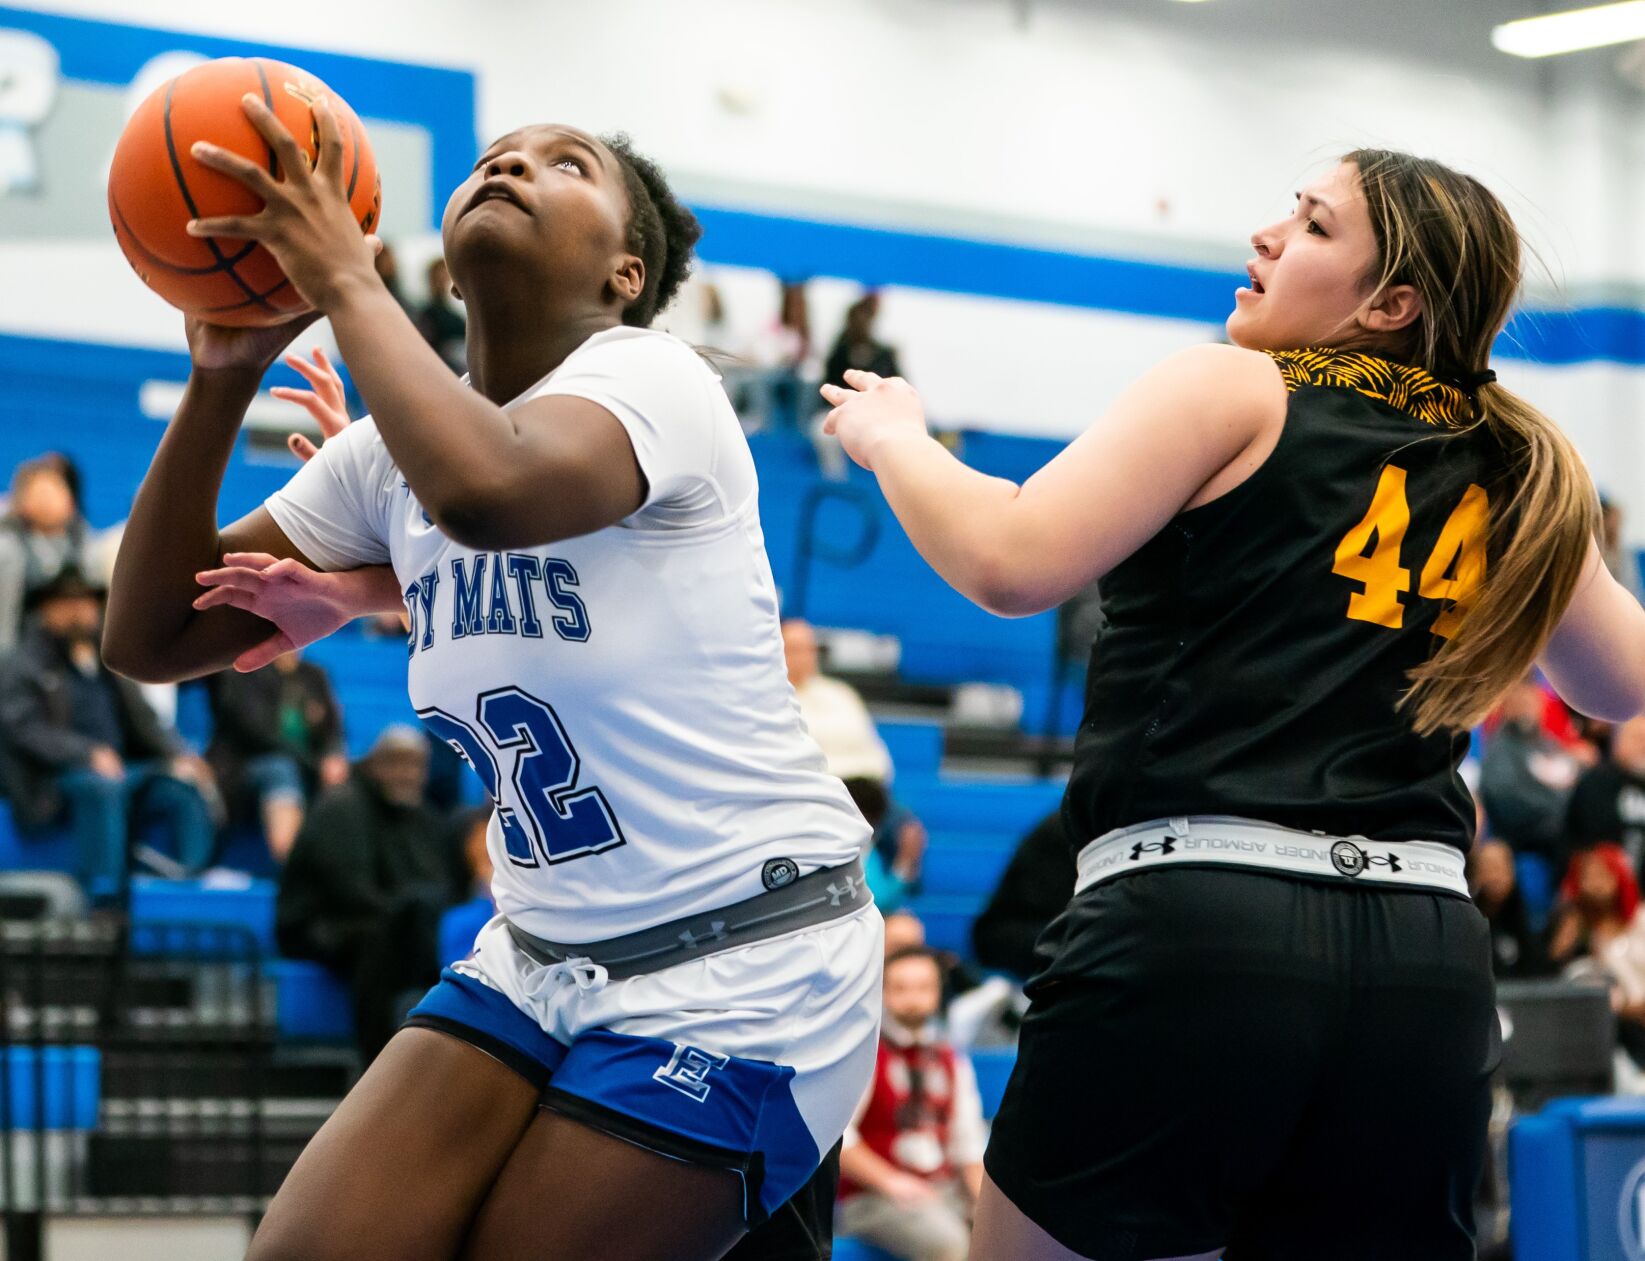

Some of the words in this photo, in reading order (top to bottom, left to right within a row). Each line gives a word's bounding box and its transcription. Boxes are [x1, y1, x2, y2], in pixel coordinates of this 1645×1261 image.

[1331, 463, 1489, 640] 44
[452, 553, 592, 643] MATS
[771, 866, 788, 880] MD
[1184, 837, 1268, 854] ARMOUR
[652, 1041, 731, 1103] E
